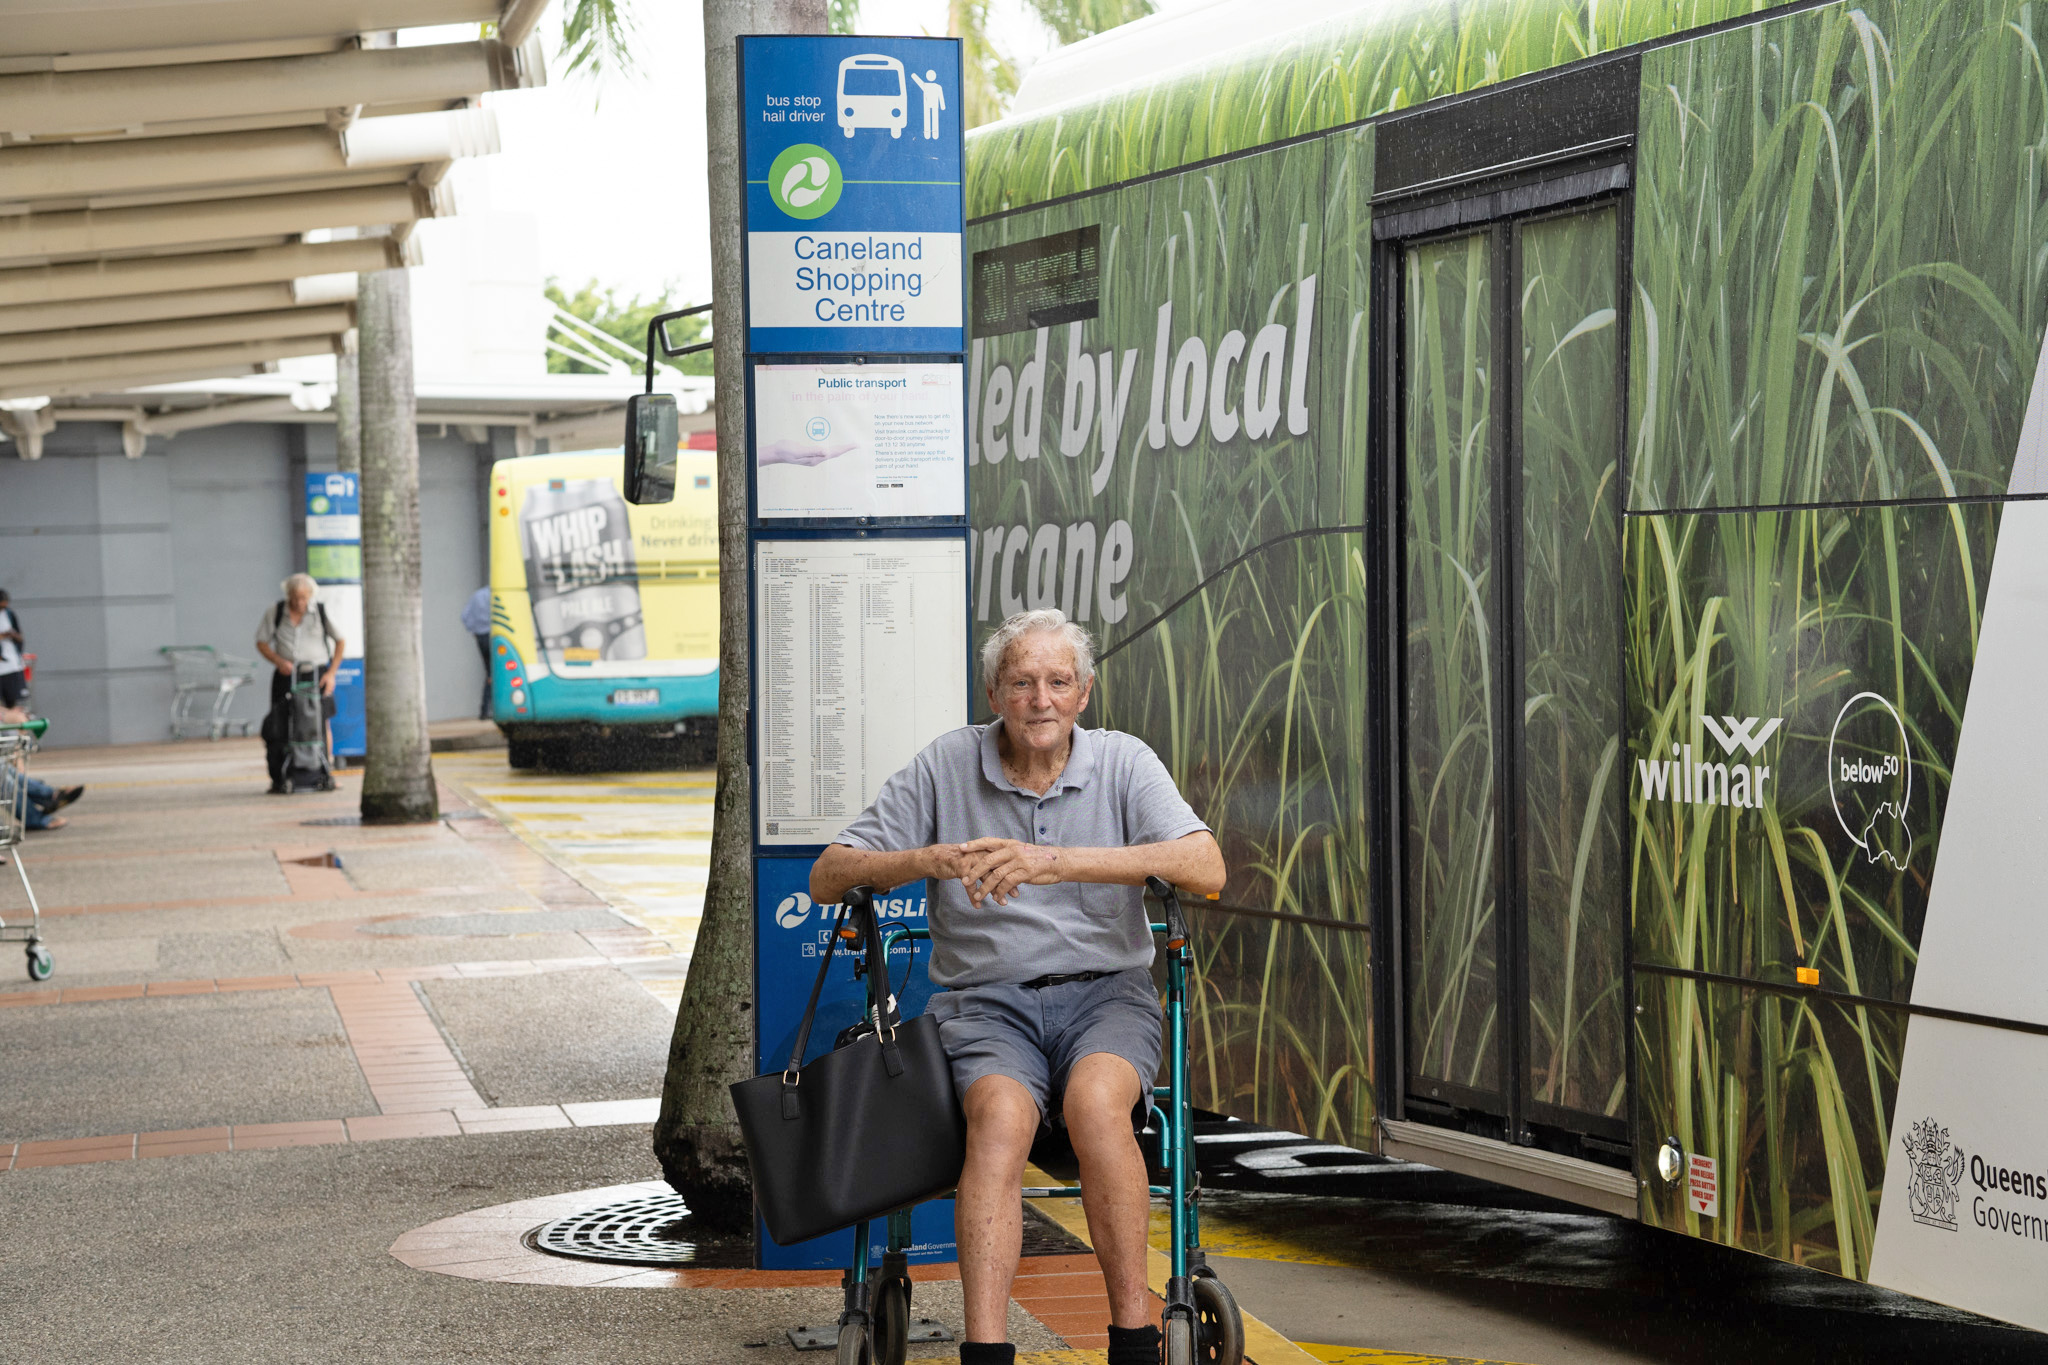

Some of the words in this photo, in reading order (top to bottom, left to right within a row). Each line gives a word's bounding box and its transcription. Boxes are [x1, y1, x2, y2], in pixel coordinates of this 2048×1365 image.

[767, 94, 790, 106] bus
[793, 95, 821, 109] stop
[763, 110, 785, 122] hail
[789, 110, 825, 122] driver
[794, 235, 922, 260] Caneland
[796, 266, 922, 297] Shopping
[815, 297, 905, 322] Centre
[818, 378, 853, 388] Public
[855, 378, 907, 390] transport
[1060, 321, 1138, 498] by
[1148, 273, 1316, 450] local
[792, 391, 802, 401] in
[806, 391, 824, 401] the
[827, 391, 855, 403] palm
[858, 391, 870, 401] of
[873, 392, 897, 403] your
[531, 505, 607, 560] WHIP
[641, 534, 683, 547] Never
[688, 532, 719, 547] driv
[1638, 742, 1770, 809] wilmar
[818, 898, 928, 920] TRNSLi
[1970, 1154, 2048, 1200] Queens
